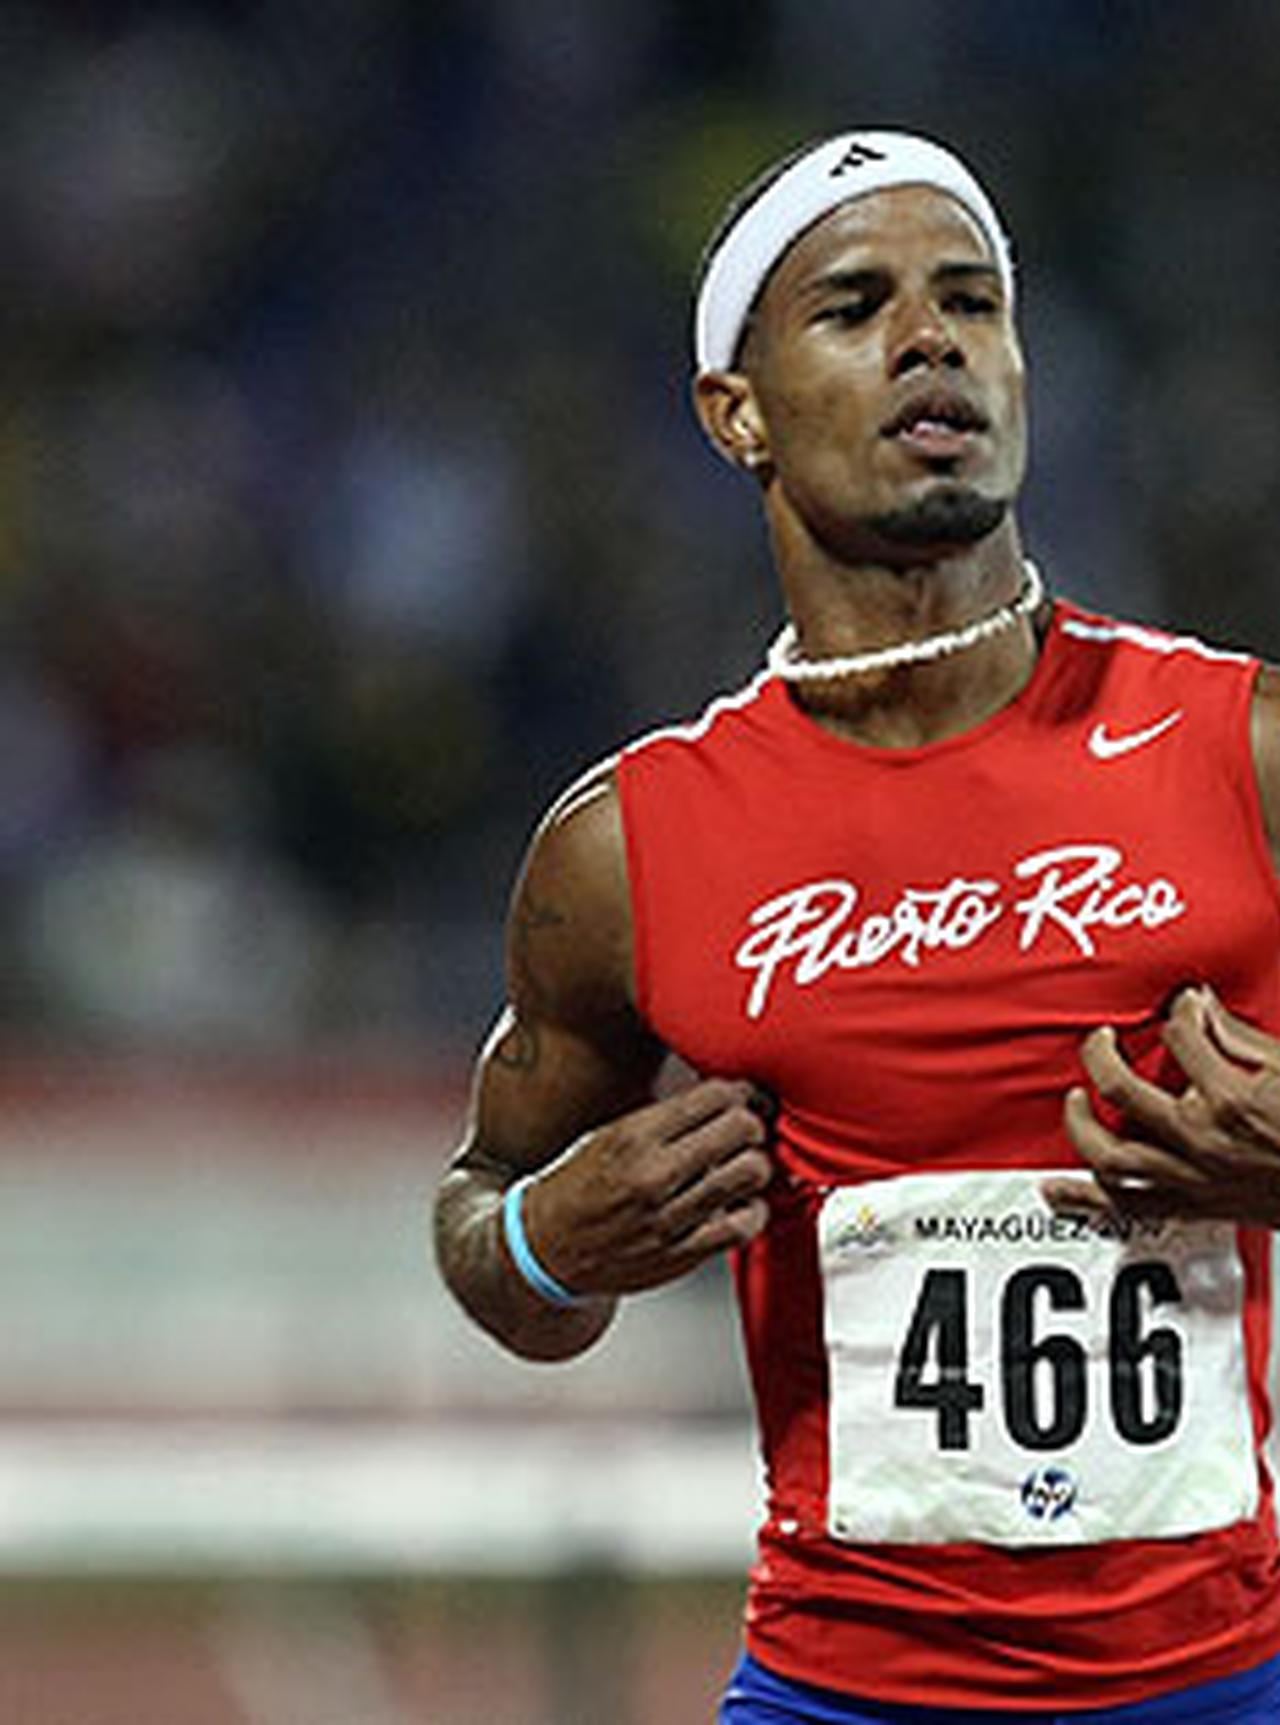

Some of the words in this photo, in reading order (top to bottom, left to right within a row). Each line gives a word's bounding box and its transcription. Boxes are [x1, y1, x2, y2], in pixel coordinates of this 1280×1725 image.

[735, 878, 1003, 1019] Puerto
[1014, 844, 1187, 957] Rico
[894, 1261, 1184, 1452] 466
